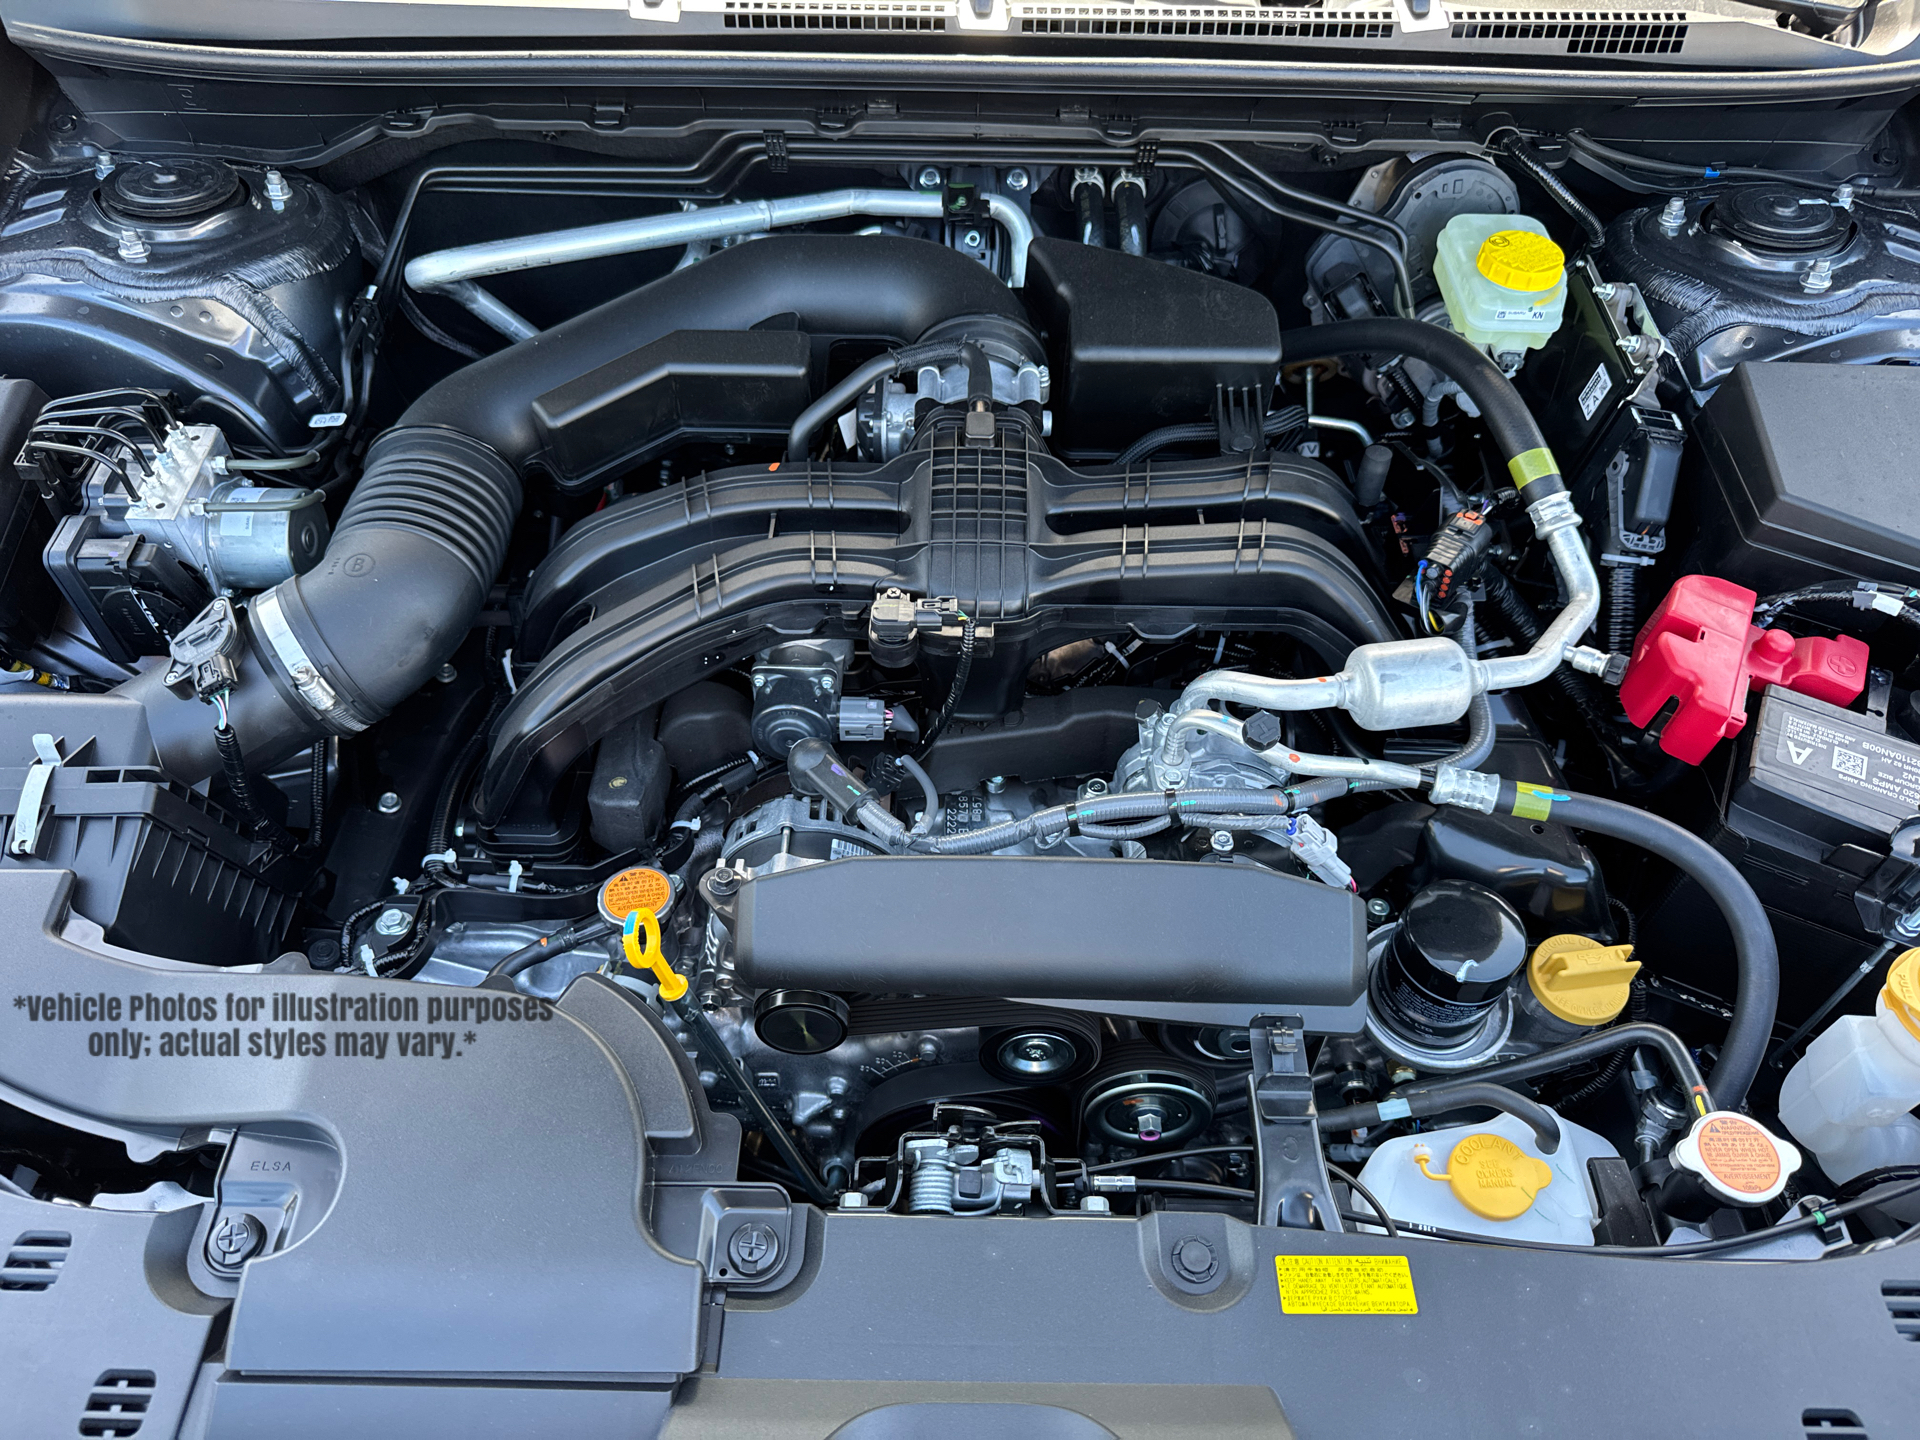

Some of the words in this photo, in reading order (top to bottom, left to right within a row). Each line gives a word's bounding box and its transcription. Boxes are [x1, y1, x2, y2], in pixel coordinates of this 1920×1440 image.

[1532, 311, 1544, 319] KN
[1881, 756, 1892, 764] AH
[1838, 773, 1859, 784] AMPS
[1877, 771, 1894, 781] SIZE
[1871, 777, 1901, 793] AMPS
[1894, 777, 1920, 790] GROUP
[1859, 781, 1898, 798] CRANKING
[1898, 795, 1919, 806] COLD
[1538, 937, 1576, 958] ENGINE
[1455, 1136, 1525, 1165] COOLANT
[250, 1160, 291, 1171] ELSA
[1479, 1159, 1499, 1169] SEE
[1475, 1168, 1514, 1178] OWNERS
[1478, 1178, 1517, 1188] MANUAL
[1302, 1257, 1323, 1265] CAUTION
[1325, 1257, 1353, 1265] ATTENTION
